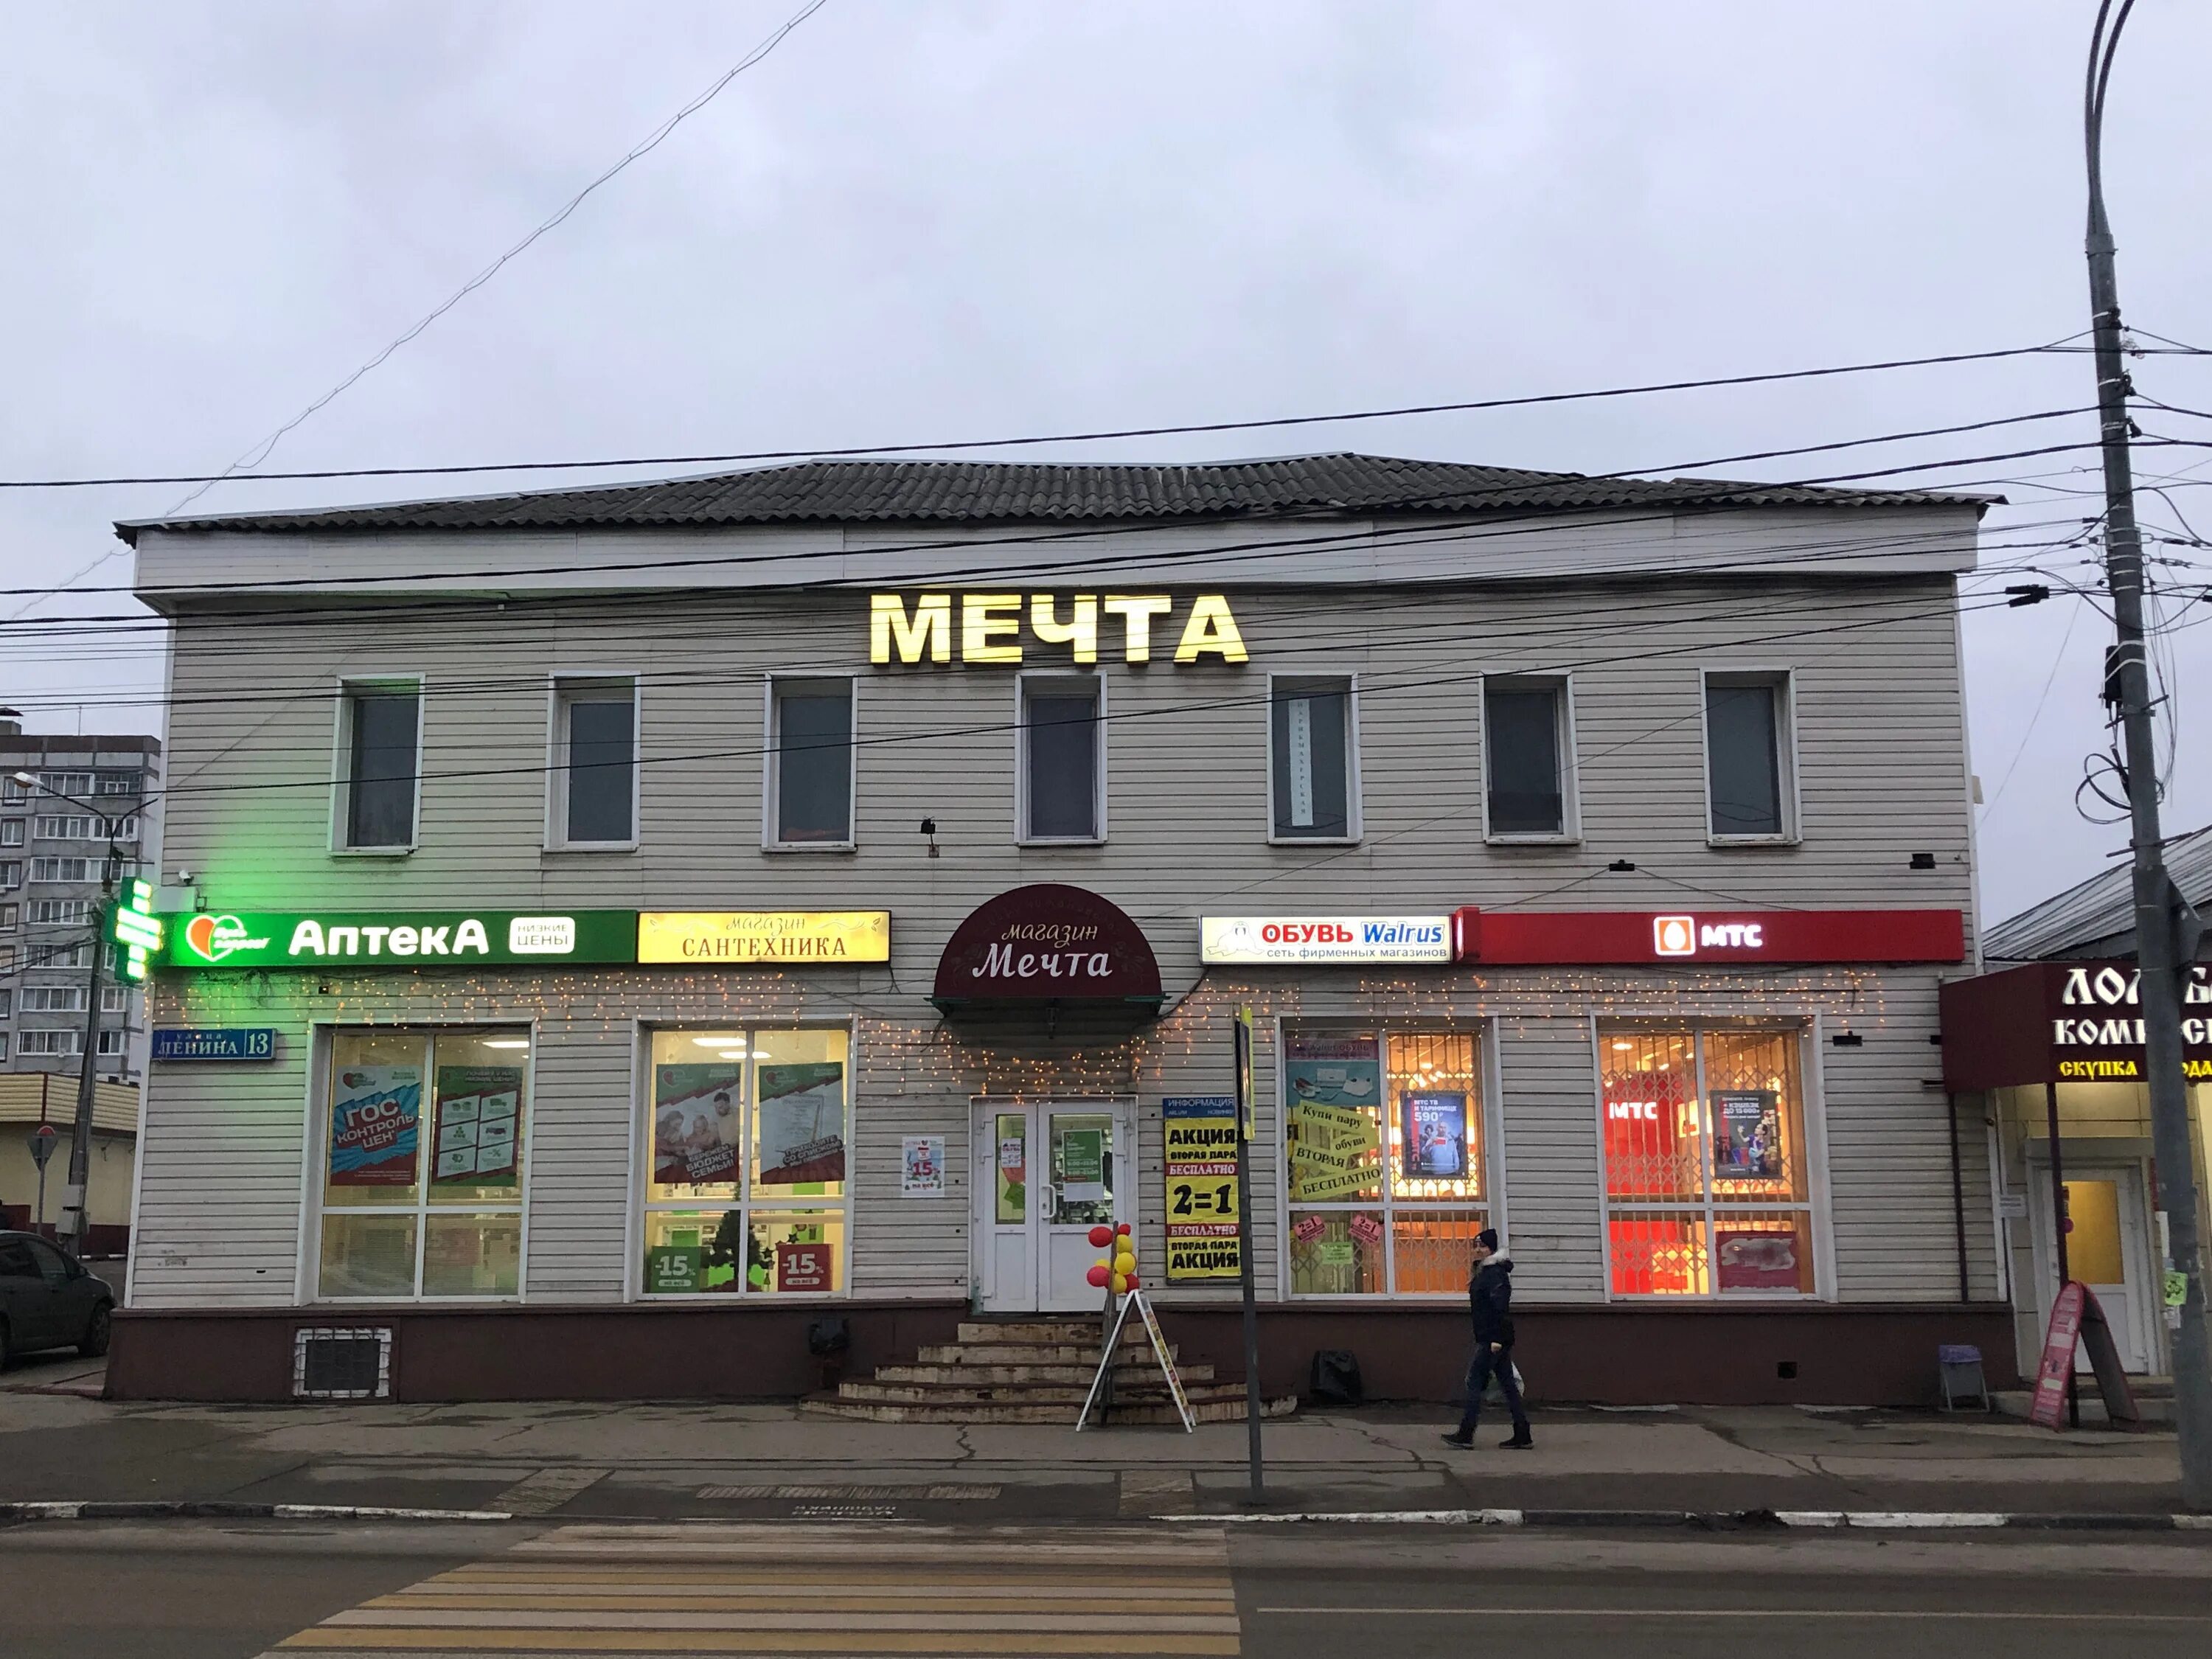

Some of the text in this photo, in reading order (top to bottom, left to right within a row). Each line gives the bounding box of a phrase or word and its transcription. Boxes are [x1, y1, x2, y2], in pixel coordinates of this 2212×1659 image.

[871, 594, 1250, 663] МЕЧТА
[518, 924, 567, 933] НИЗКИЕ
[726, 917, 805, 936] магазин
[1001, 924, 1099, 948] магазин
[1262, 923, 1442, 943] ОБУВЬ Walrus
[1701, 925, 1763, 947] МТС
[518, 935, 568, 946] ЦЕНЫ
[682, 937, 847, 957] САНТЕХНИКА
[972, 943, 1113, 978] Мечта
[1267, 947, 1447, 959] сеть фирменных магазинов
[159, 1033, 269, 1055] ЛЕНИНА 13
[2059, 1060, 2138, 1080] СКУПКА
[346, 1098, 399, 1127] ГОС
[1168, 1098, 1234, 1107] ИНФОРМАЦИЯ
[1609, 1102, 1658, 1120] МТС
[1302, 1106, 1363, 1130] Купи пару
[336, 1114, 414, 1144] КОНТРОЛЬ
[1169, 1129, 1236, 1147] АКЦИЯ
[1335, 1137, 1366, 1150] обуви
[686, 1150, 735, 1172] БЮДЖЕТ
[1170, 1150, 1237, 1160] ВТОРАЯ ПАРА
[1296, 1147, 1345, 1167] ВТОРАЯ
[1169, 1165, 1236, 1175] БЕСПЛАТНО
[1303, 1169, 1381, 1194] БЕСПЛАТНО
[1173, 1184, 1232, 1215] 2=1
[1171, 1225, 1237, 1236] БЕСПЛАТНО
[1171, 1241, 1238, 1251] ВТОРАЯ ПАРА
[1172, 1252, 1239, 1270] АКЦИЯ
